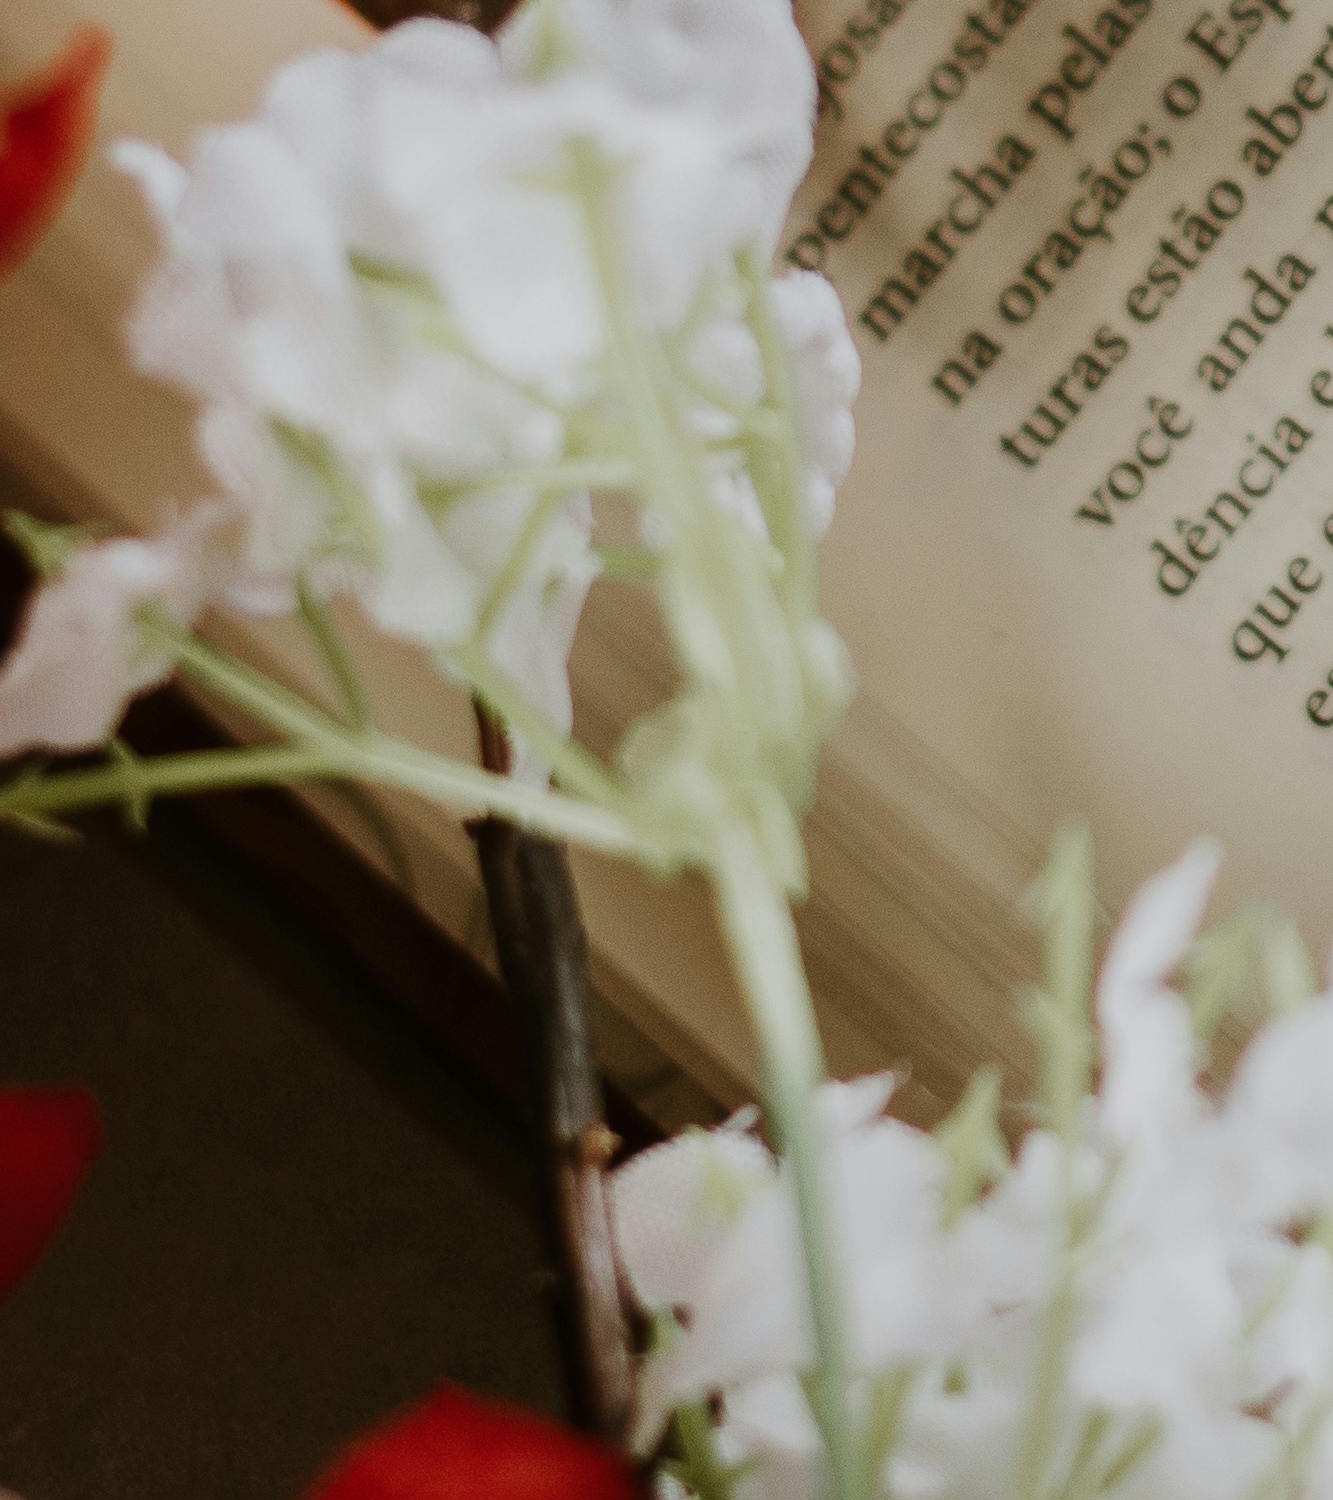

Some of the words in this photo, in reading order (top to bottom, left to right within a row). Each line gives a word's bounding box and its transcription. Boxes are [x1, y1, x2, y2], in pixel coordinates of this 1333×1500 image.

[858, 132, 1030, 347] marcha
[997, 324, 1131, 470] turas
[1123, 177, 1246, 325] estão
[1148, 414, 1315, 599] dência
